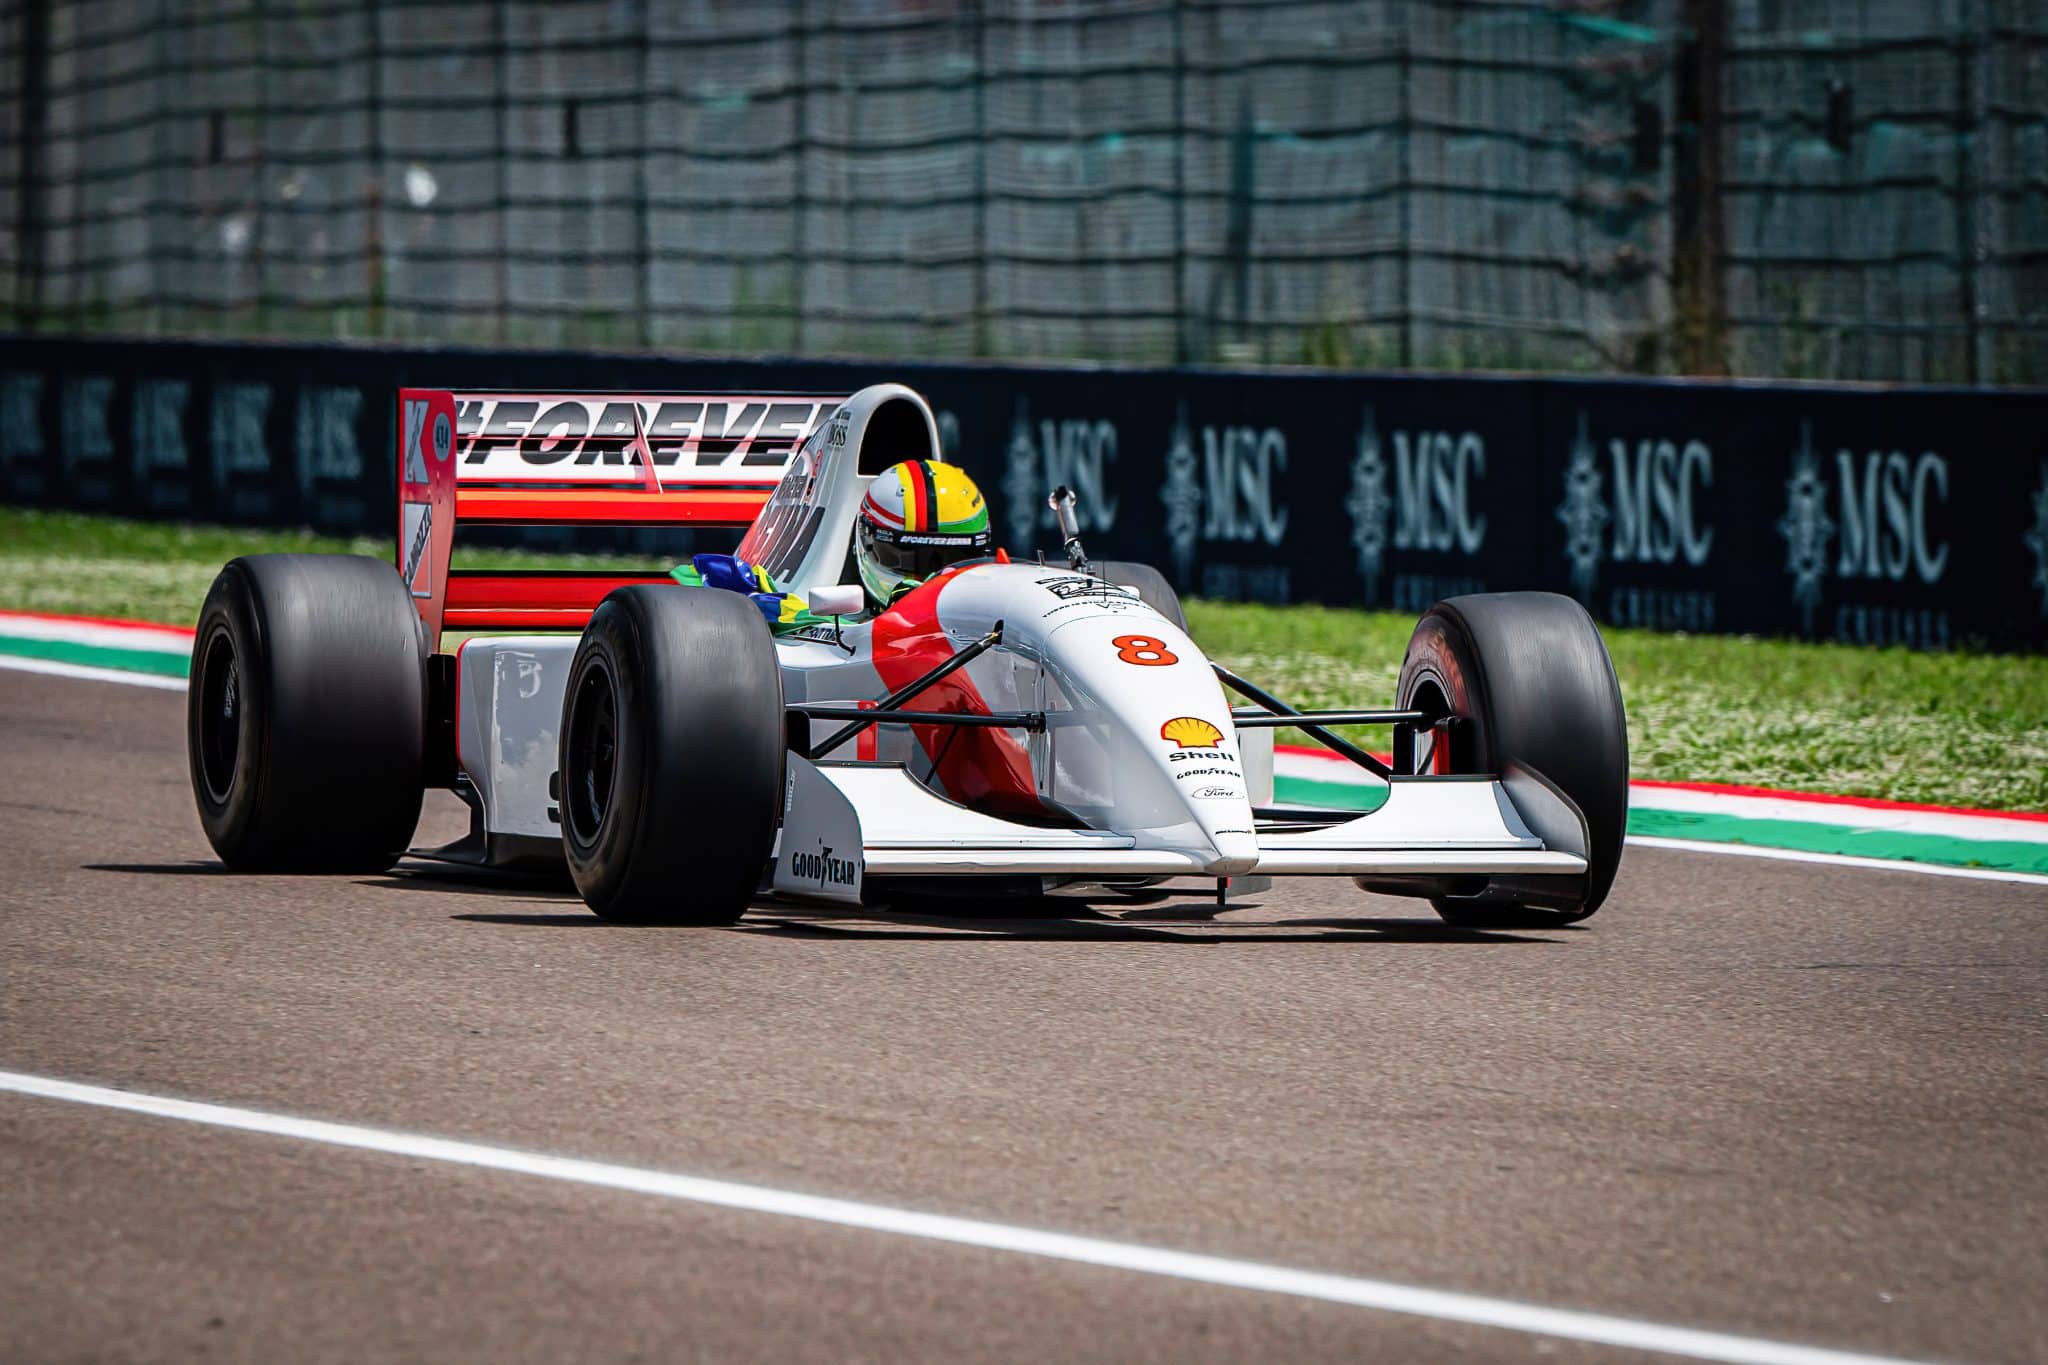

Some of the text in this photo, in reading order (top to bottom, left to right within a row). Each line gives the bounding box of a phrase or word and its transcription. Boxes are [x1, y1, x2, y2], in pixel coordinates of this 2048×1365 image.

[1203, 425, 1288, 548] MSC
[1395, 430, 1486, 555] MSC
[1610, 438, 1714, 567] MSC
[1837, 449, 1950, 584] MSC
[1112, 635, 1179, 667] 8
[1169, 751, 1235, 762] Shell
[1176, 767, 1241, 780] GOODYEAR
[792, 851, 856, 886] GOODYEAR
